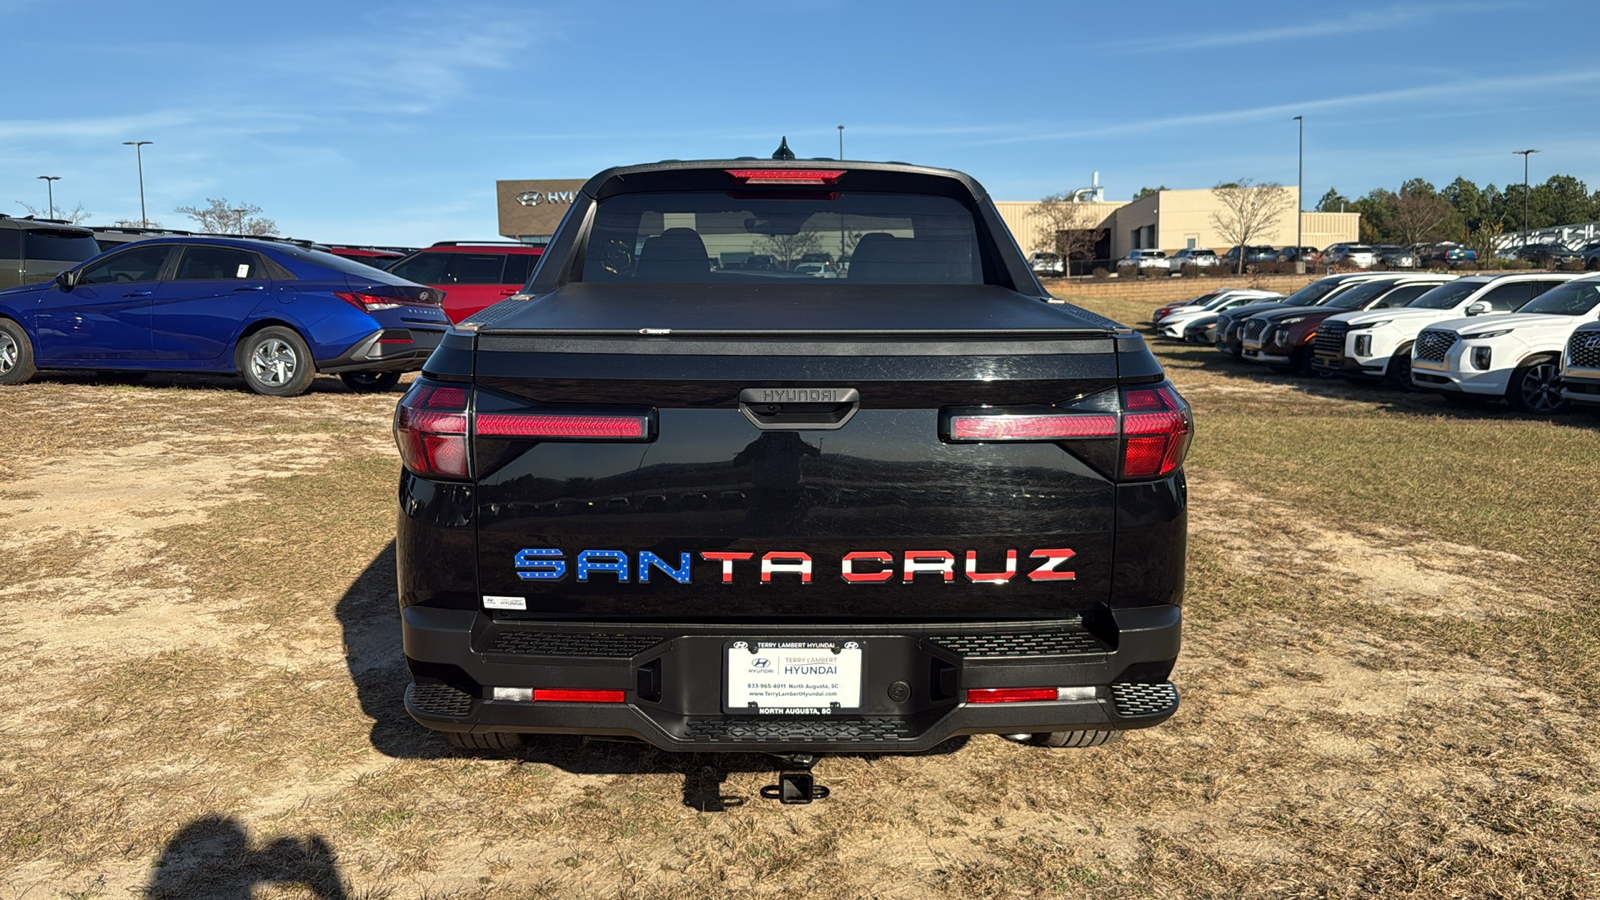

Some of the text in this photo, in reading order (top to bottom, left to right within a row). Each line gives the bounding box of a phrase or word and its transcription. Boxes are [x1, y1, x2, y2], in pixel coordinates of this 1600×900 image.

[763, 390, 837, 401] HYUNDAI
[514, 548, 1077, 584] SANTA CRUZ
[784, 666, 837, 675] HYUNDAI
